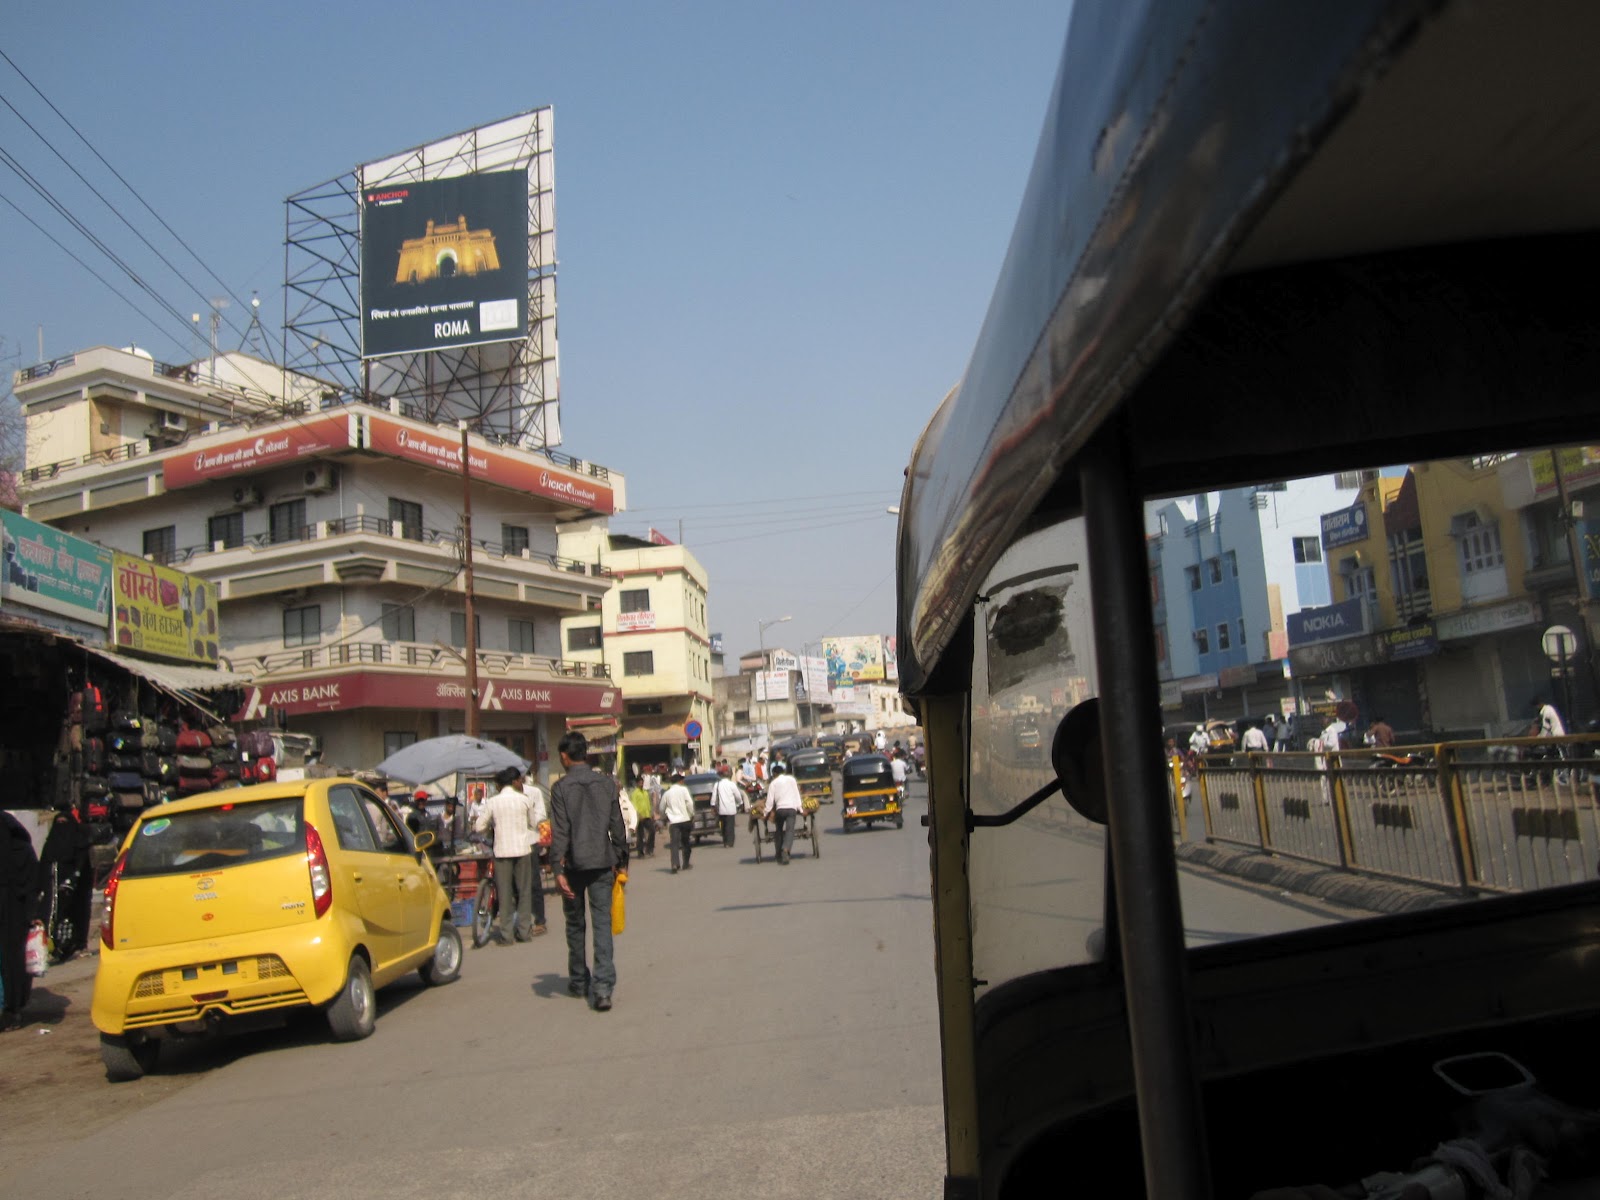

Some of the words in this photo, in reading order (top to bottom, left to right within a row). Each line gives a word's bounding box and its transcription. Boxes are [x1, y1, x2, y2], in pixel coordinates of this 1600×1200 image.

[375, 190, 409, 200] ANCHOR
[434, 319, 470, 338] ROMA
[548, 480, 567, 492] ICICI
[1303, 612, 1345, 633] NOKIA
[269, 691, 299, 705] AXIS
[303, 683, 340, 700] BANK
[500, 688, 523, 700] AXIS
[525, 689, 551, 701] BANK
